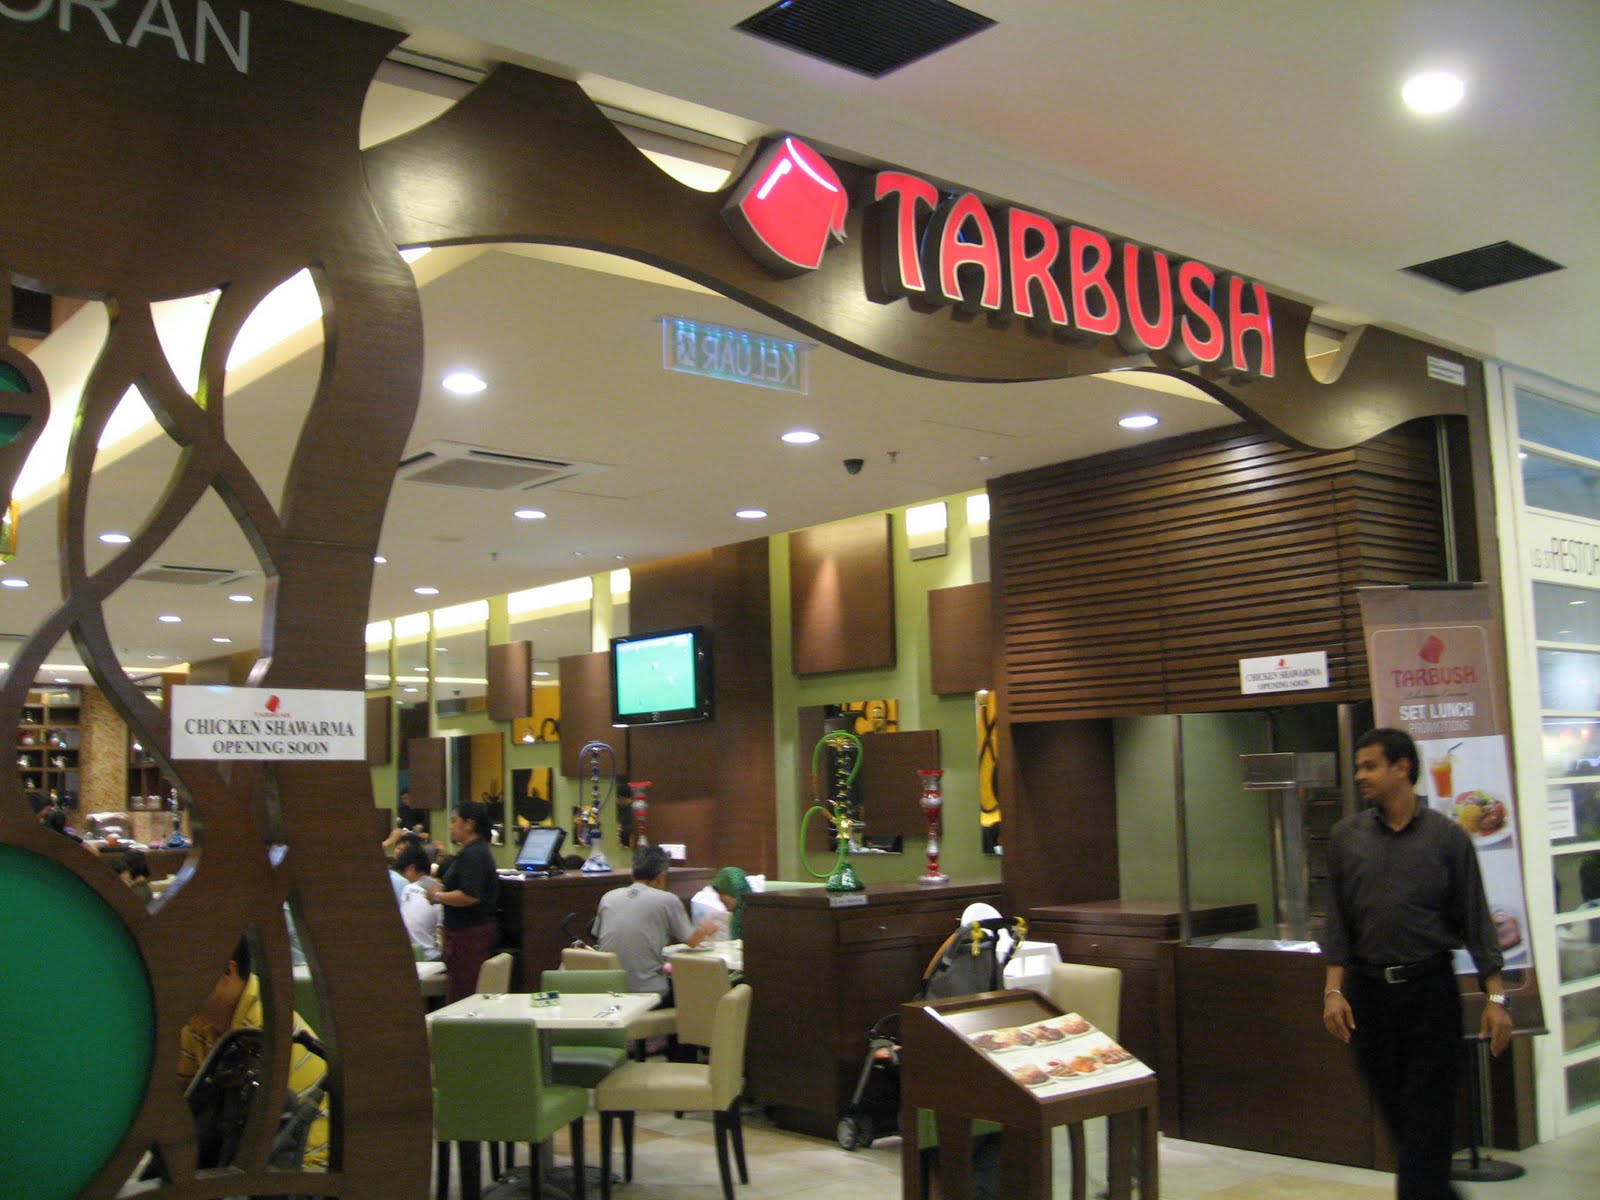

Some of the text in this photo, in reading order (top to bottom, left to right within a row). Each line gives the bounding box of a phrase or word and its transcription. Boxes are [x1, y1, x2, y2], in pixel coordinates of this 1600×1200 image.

[875, 170, 1275, 378] TARBUSH
[1391, 665, 1478, 688] TARBUSH
[1399, 702, 1475, 721] SET LUNCH
[185, 718, 355, 737] CHICKEN SHAWARMA
[212, 740, 329, 755] OPENING SOON
